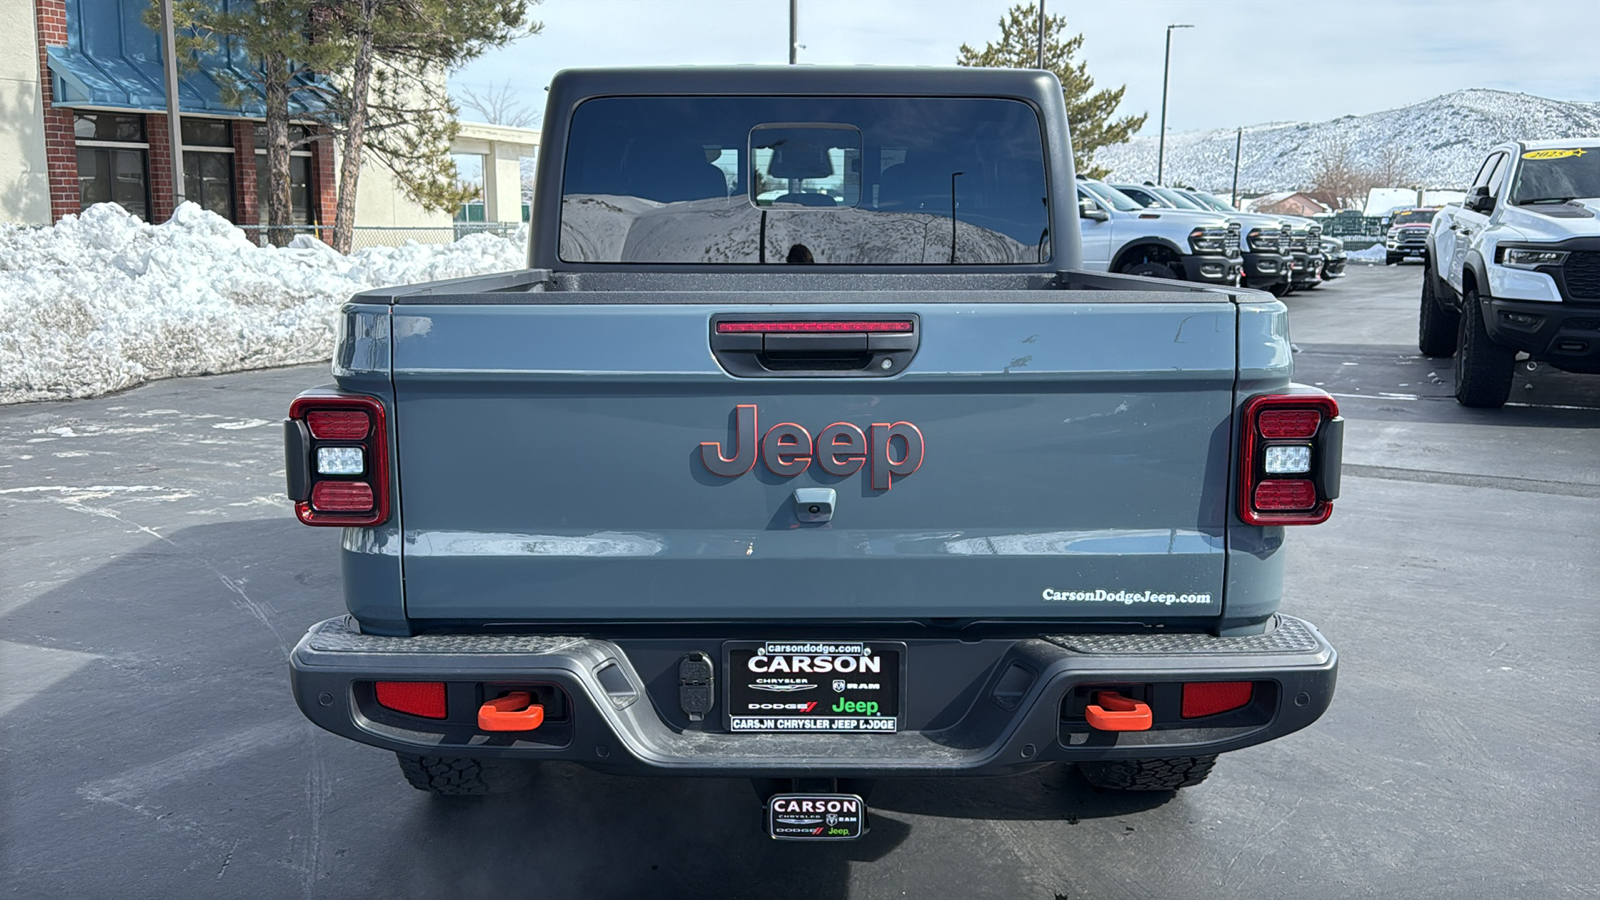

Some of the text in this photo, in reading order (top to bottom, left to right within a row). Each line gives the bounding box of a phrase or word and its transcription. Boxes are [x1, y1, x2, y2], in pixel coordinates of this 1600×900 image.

[700, 404, 925, 490] Jeep
[1042, 588, 1211, 605] CarsonDodgeJeep.com
[768, 643, 861, 654] carsondodge.com
[748, 655, 881, 673] CARSON
[832, 697, 879, 715] Jeep
[777, 719, 830, 729] CHRYSLER
[831, 719, 857, 729] JEEP
[774, 800, 857, 813] CARSON
[828, 827, 849, 836] Jeep
